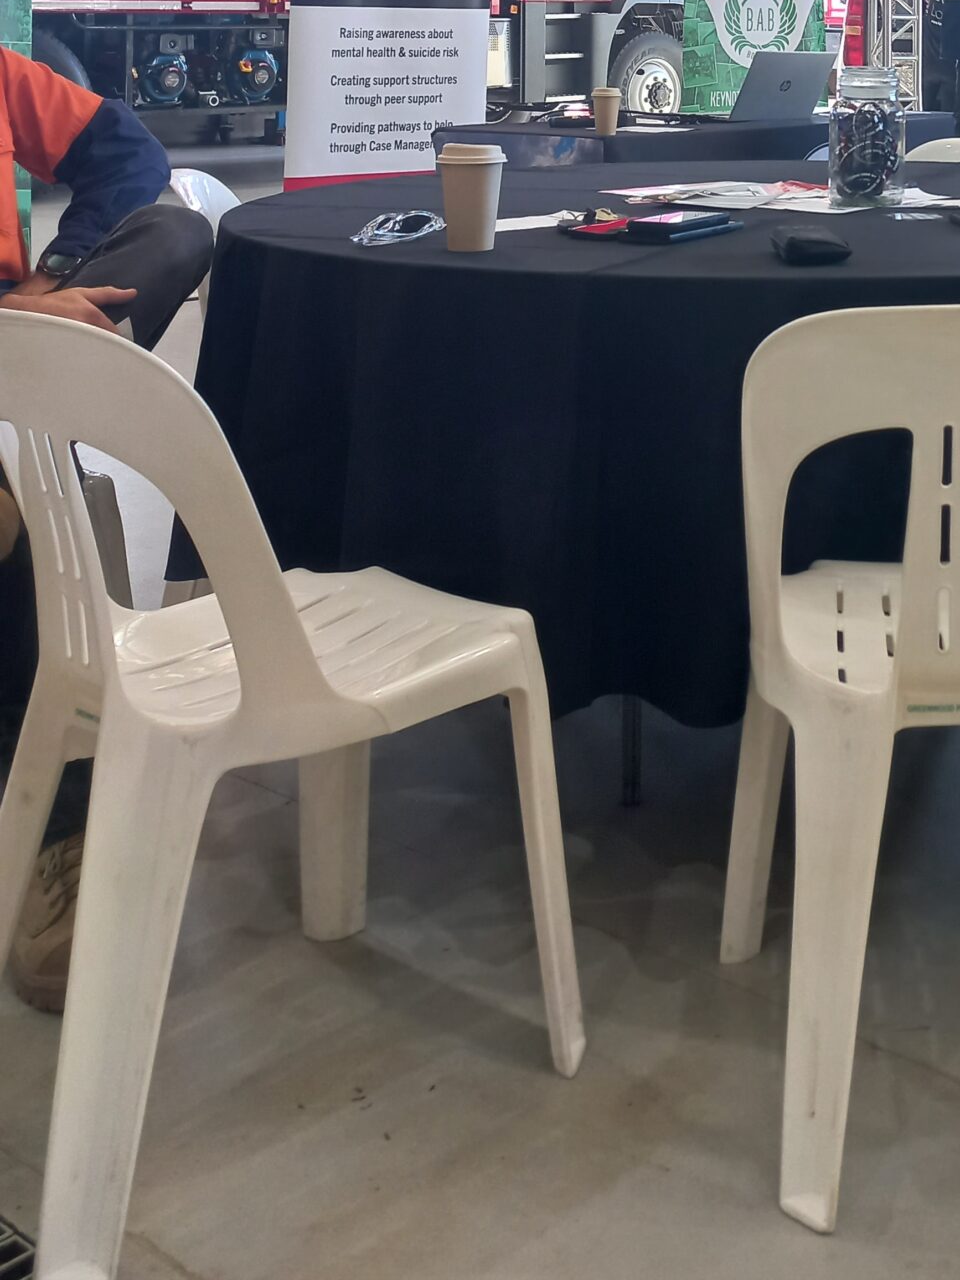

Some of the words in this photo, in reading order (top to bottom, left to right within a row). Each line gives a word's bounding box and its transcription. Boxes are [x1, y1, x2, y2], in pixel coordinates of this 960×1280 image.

[339, 27, 374, 40] Raising
[376, 30, 426, 40] awareness
[428, 28, 454, 40] about
[332, 46, 364, 58] mental
[366, 46, 396, 58] health
[398, 46, 406, 58] &
[408, 46, 440, 58] suicide
[442, 46, 458, 58] risk
[330, 75, 370, 88] Creating
[372, 75, 410, 88] support
[412, 74, 458, 85] structures
[345, 94, 382, 106] through
[384, 96, 406, 106] peer
[408, 92, 442, 105] support
[330, 122, 375, 135] Providing
[378, 121, 421, 134] pathways
[424, 121, 432, 131] to
[330, 142, 366, 154] through
[370, 140, 392, 151] Case
